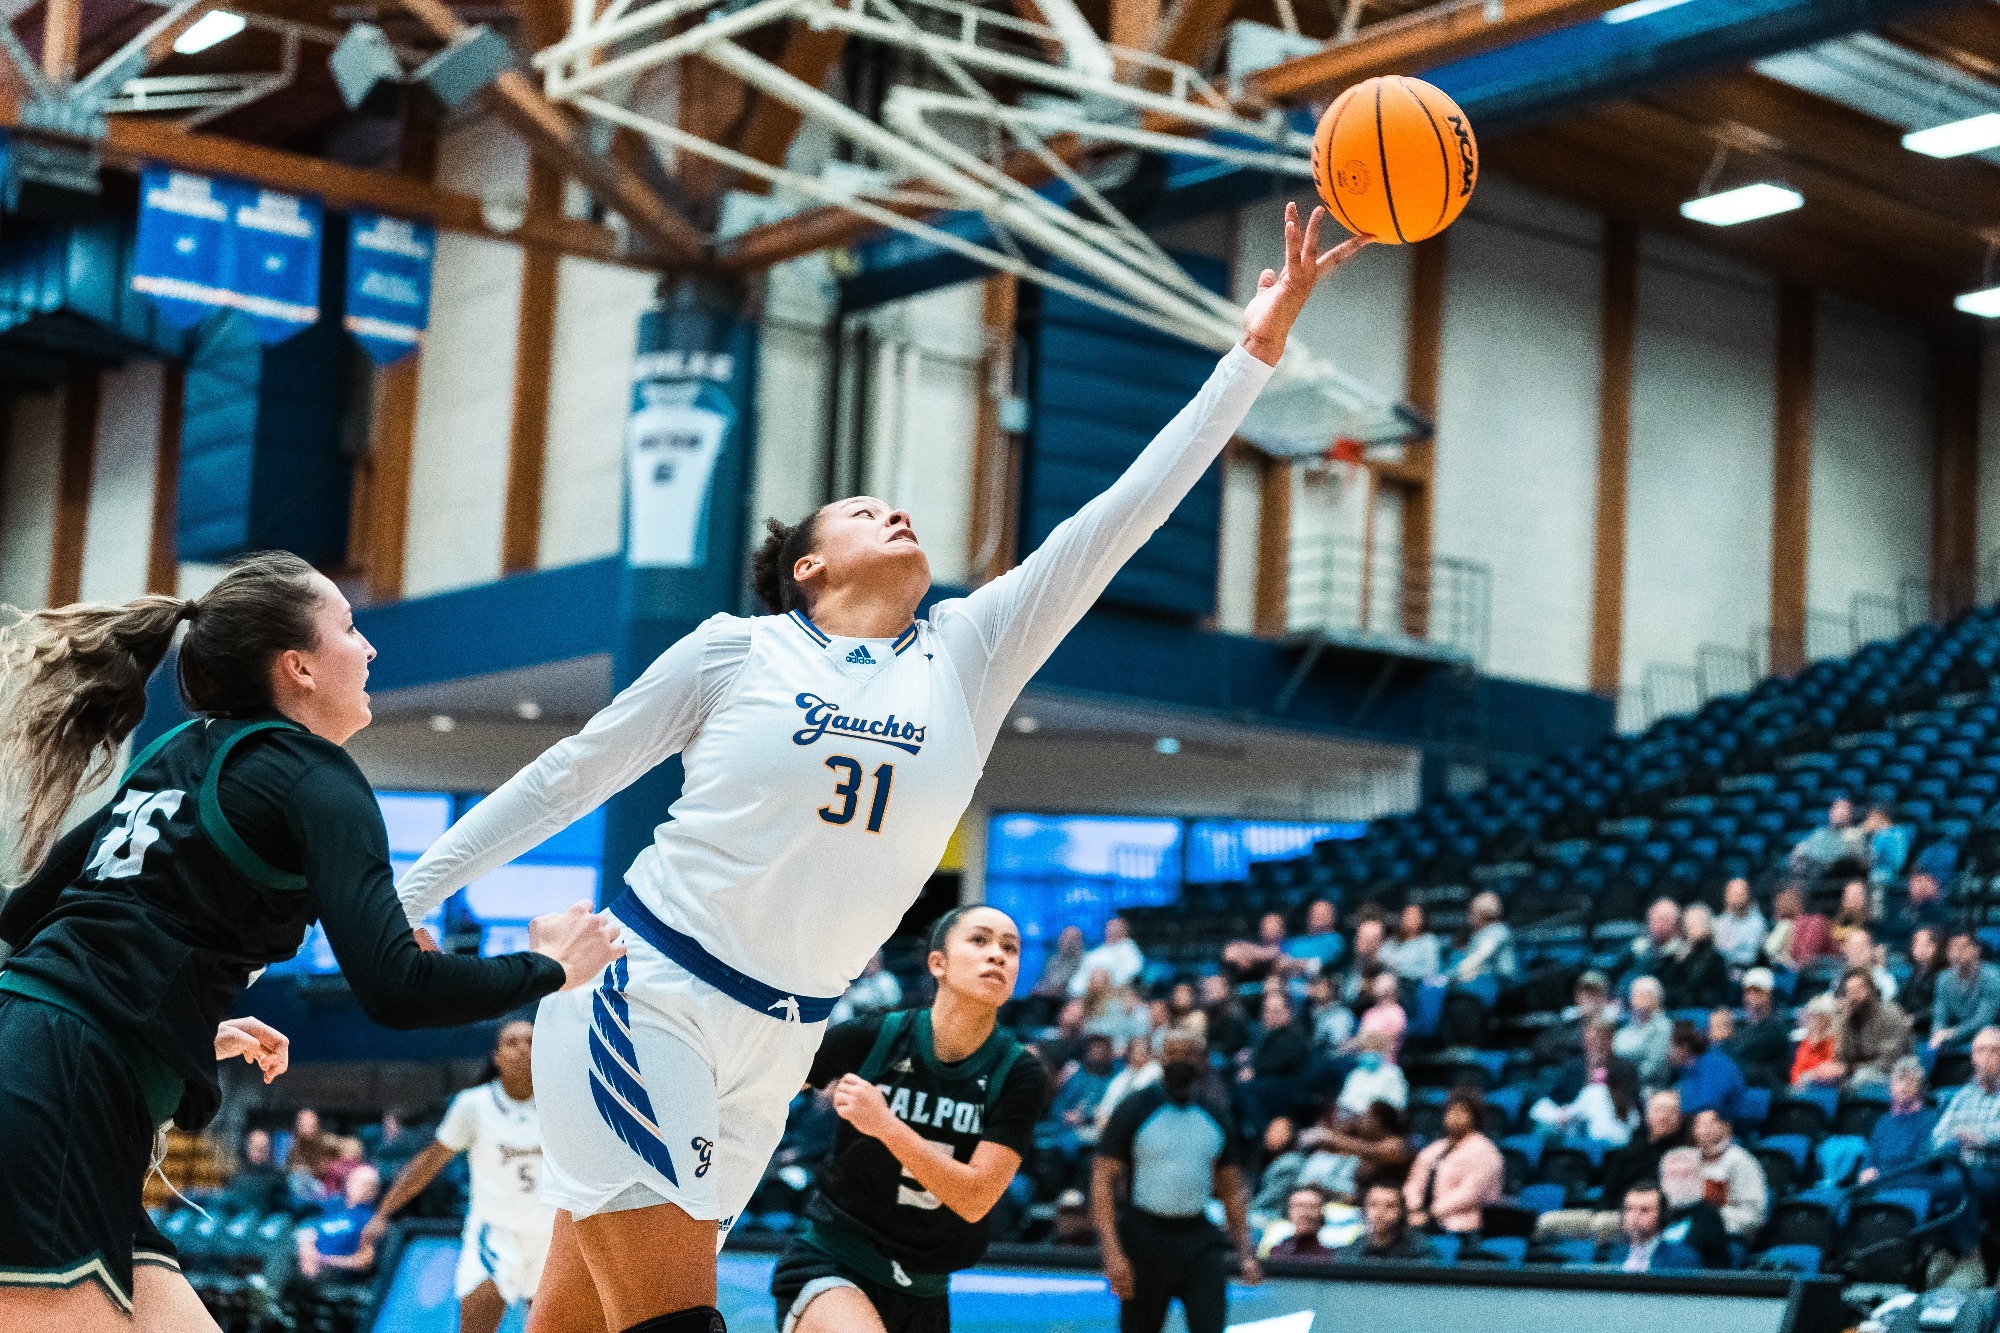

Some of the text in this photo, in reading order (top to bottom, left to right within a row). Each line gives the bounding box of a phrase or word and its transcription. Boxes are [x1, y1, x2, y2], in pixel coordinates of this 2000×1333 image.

[1446, 115, 1474, 197] NCAA
[845, 655, 877, 665] adidas
[792, 692, 927, 754] Gauchos
[816, 753, 895, 835] 31
